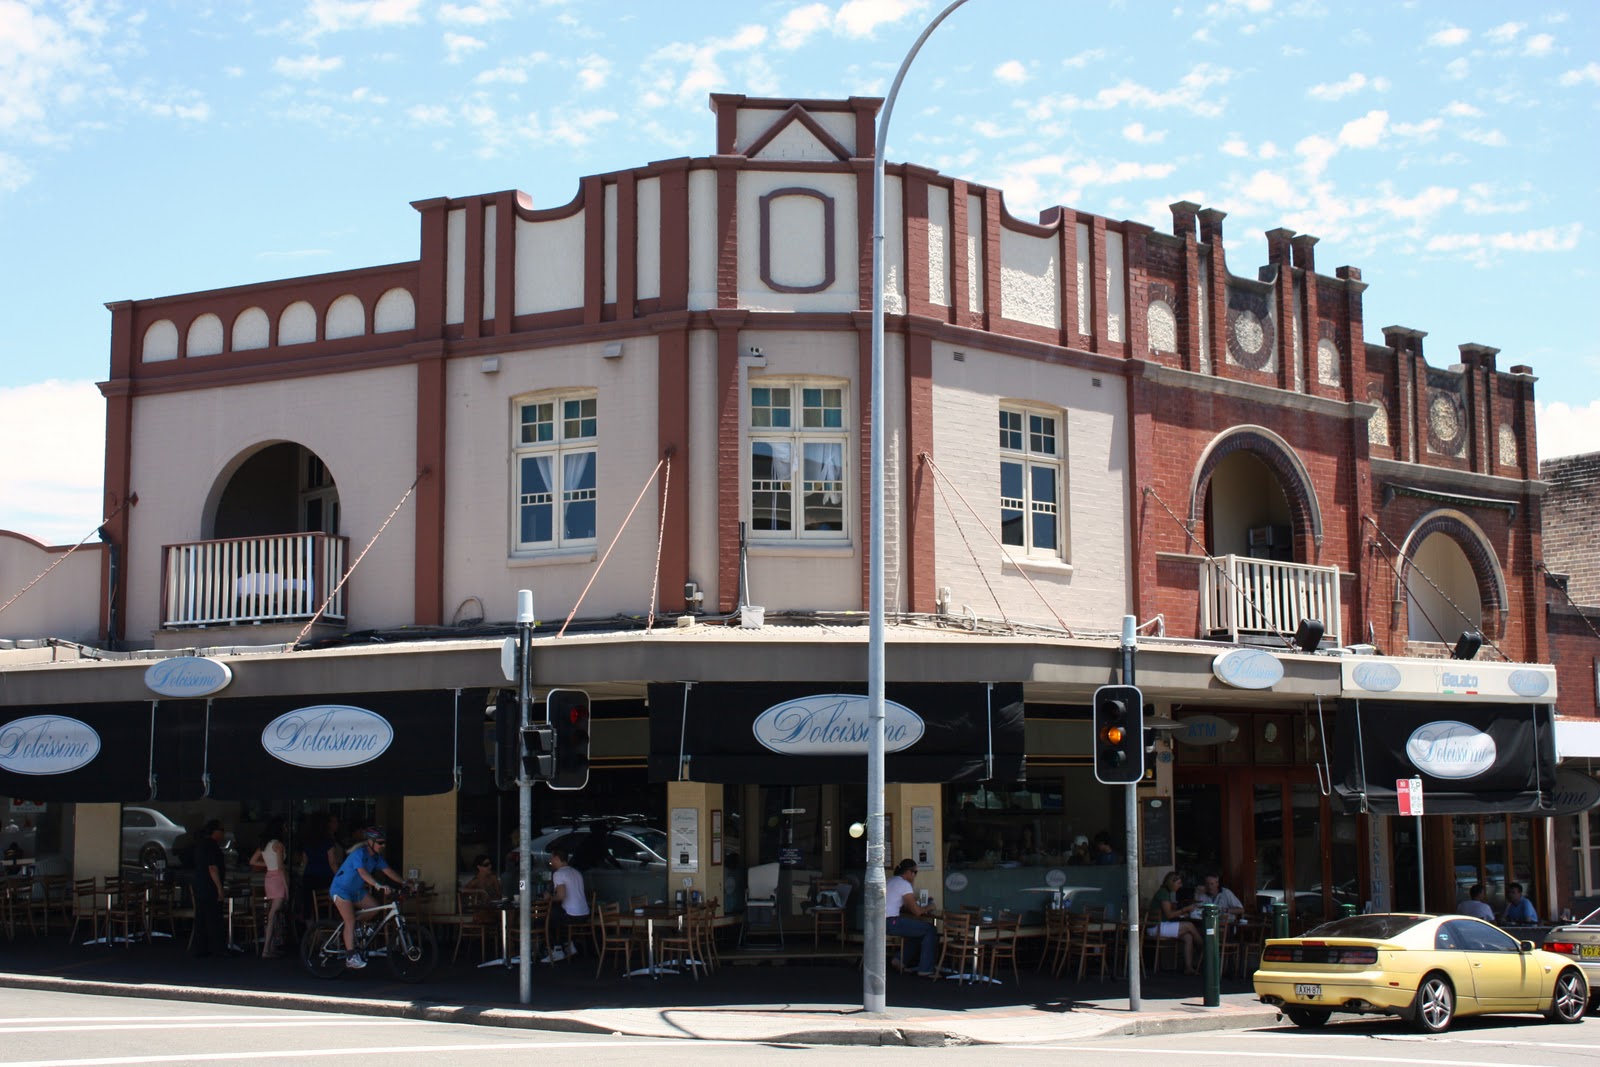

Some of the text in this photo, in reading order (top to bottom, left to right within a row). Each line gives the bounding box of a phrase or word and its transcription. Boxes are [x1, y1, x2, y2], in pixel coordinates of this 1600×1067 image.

[152, 660, 217, 688] Dolcissimo
[1442, 672, 1478, 688] Gelato
[0, 720, 89, 759] Dolcissimo
[273, 709, 378, 751] Dolcissimo
[1188, 722, 1217, 737] ATM
[1416, 726, 1487, 762] Dolcissimo
